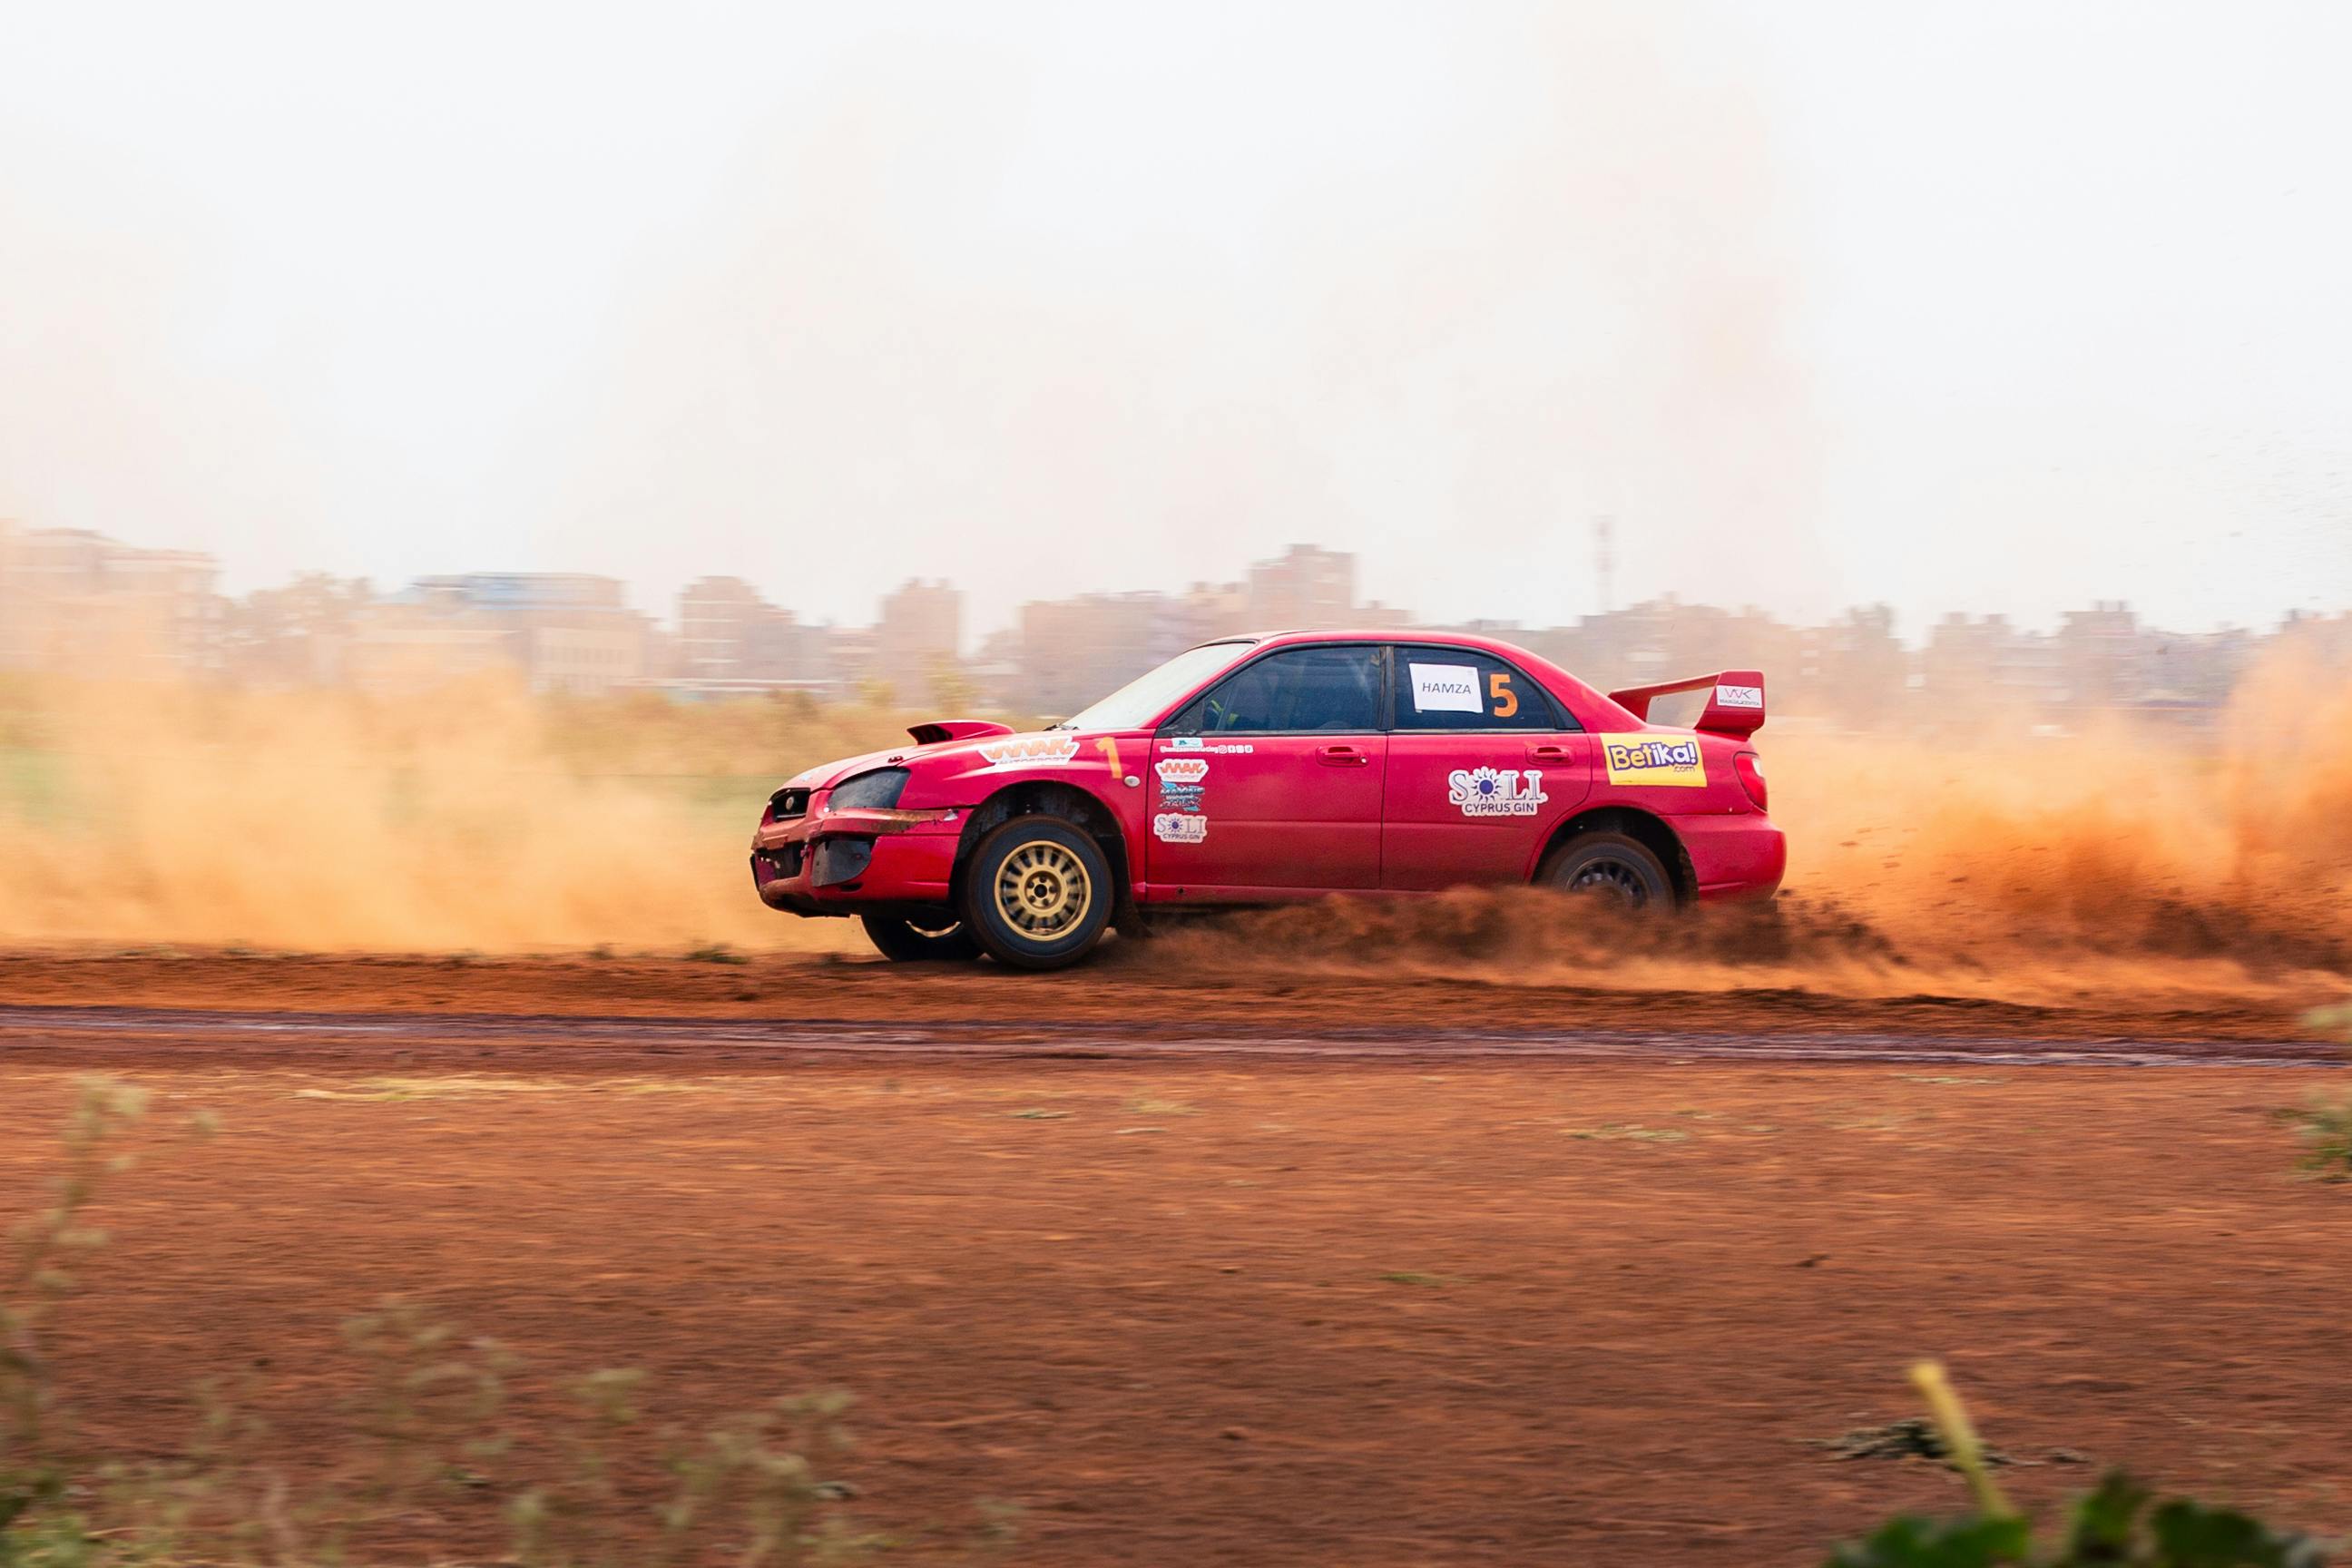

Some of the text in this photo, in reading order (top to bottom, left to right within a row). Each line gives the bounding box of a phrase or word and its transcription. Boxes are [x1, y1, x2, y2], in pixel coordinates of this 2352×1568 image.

[1422, 682, 1472, 694] HAMZA
[1490, 673, 1519, 718] 5
[1095, 736, 1122, 779] 1
[1609, 742, 1698, 770] Betika!
[1465, 803, 1534, 813] CYPRUS GIN
